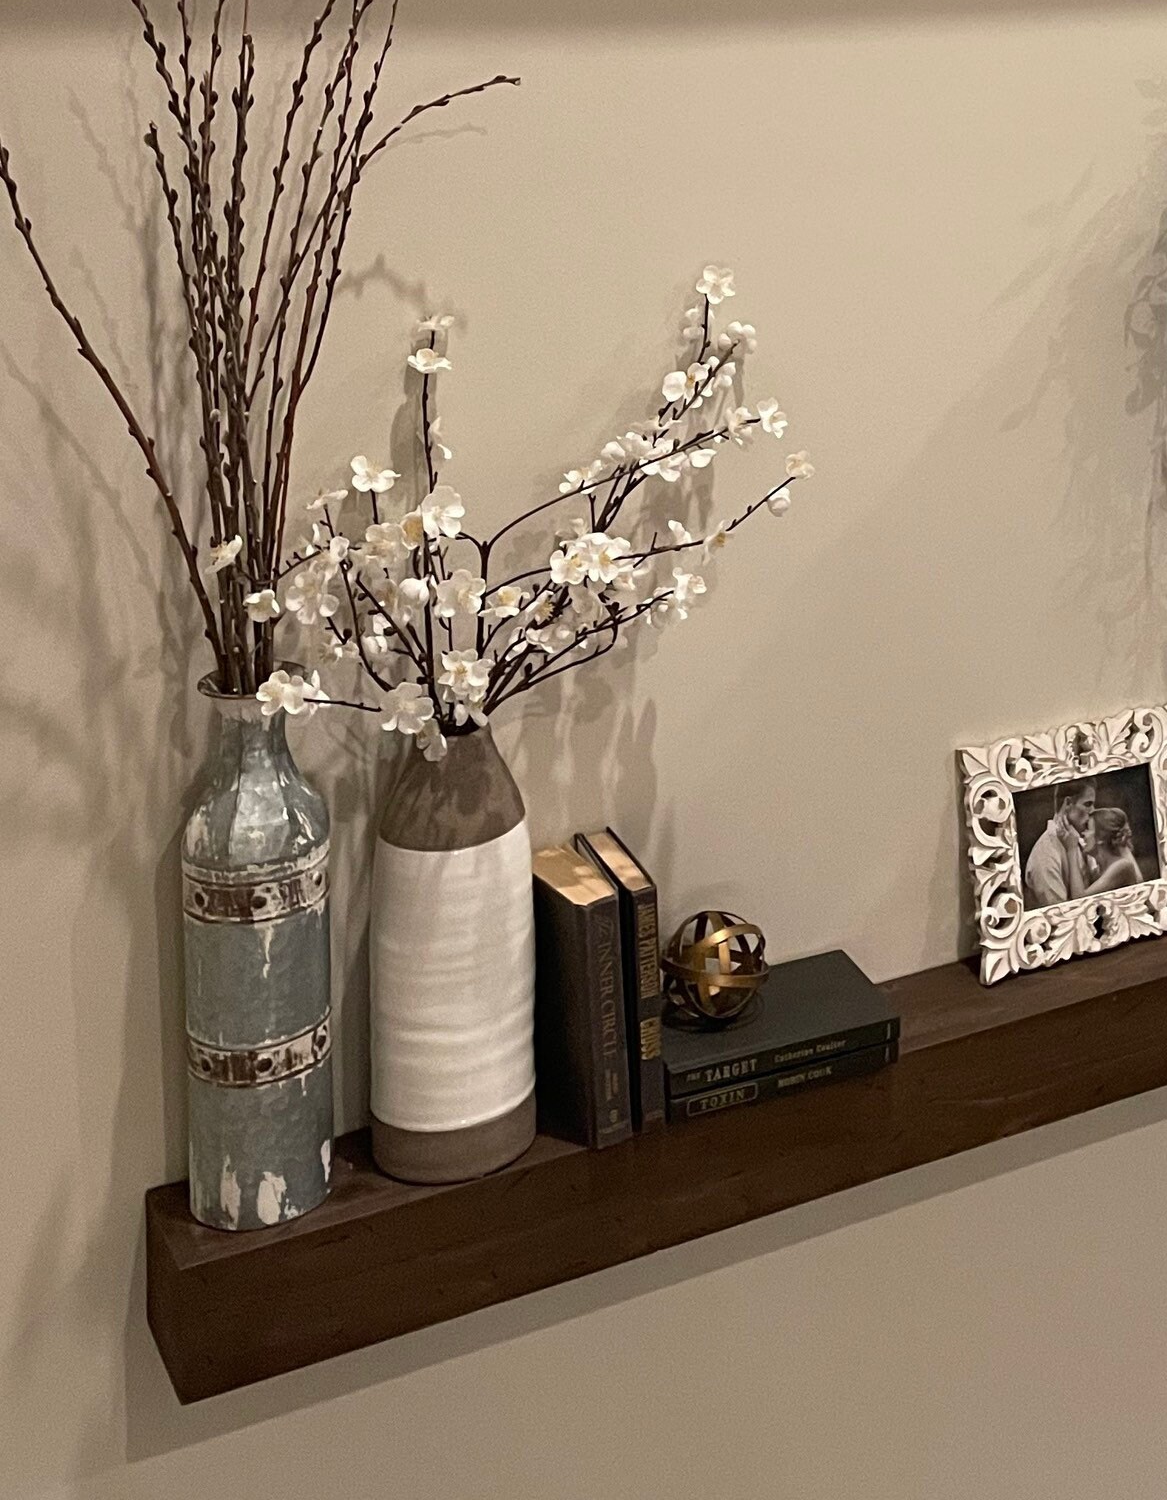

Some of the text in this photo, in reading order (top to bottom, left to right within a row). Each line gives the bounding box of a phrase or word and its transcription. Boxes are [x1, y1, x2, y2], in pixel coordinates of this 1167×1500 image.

[599, 941, 614, 998] INNER
[637, 902, 659, 999] JAMES PATTERSON
[704, 1058, 758, 1082] TARGET
[699, 1088, 745, 1110] TOXIN
